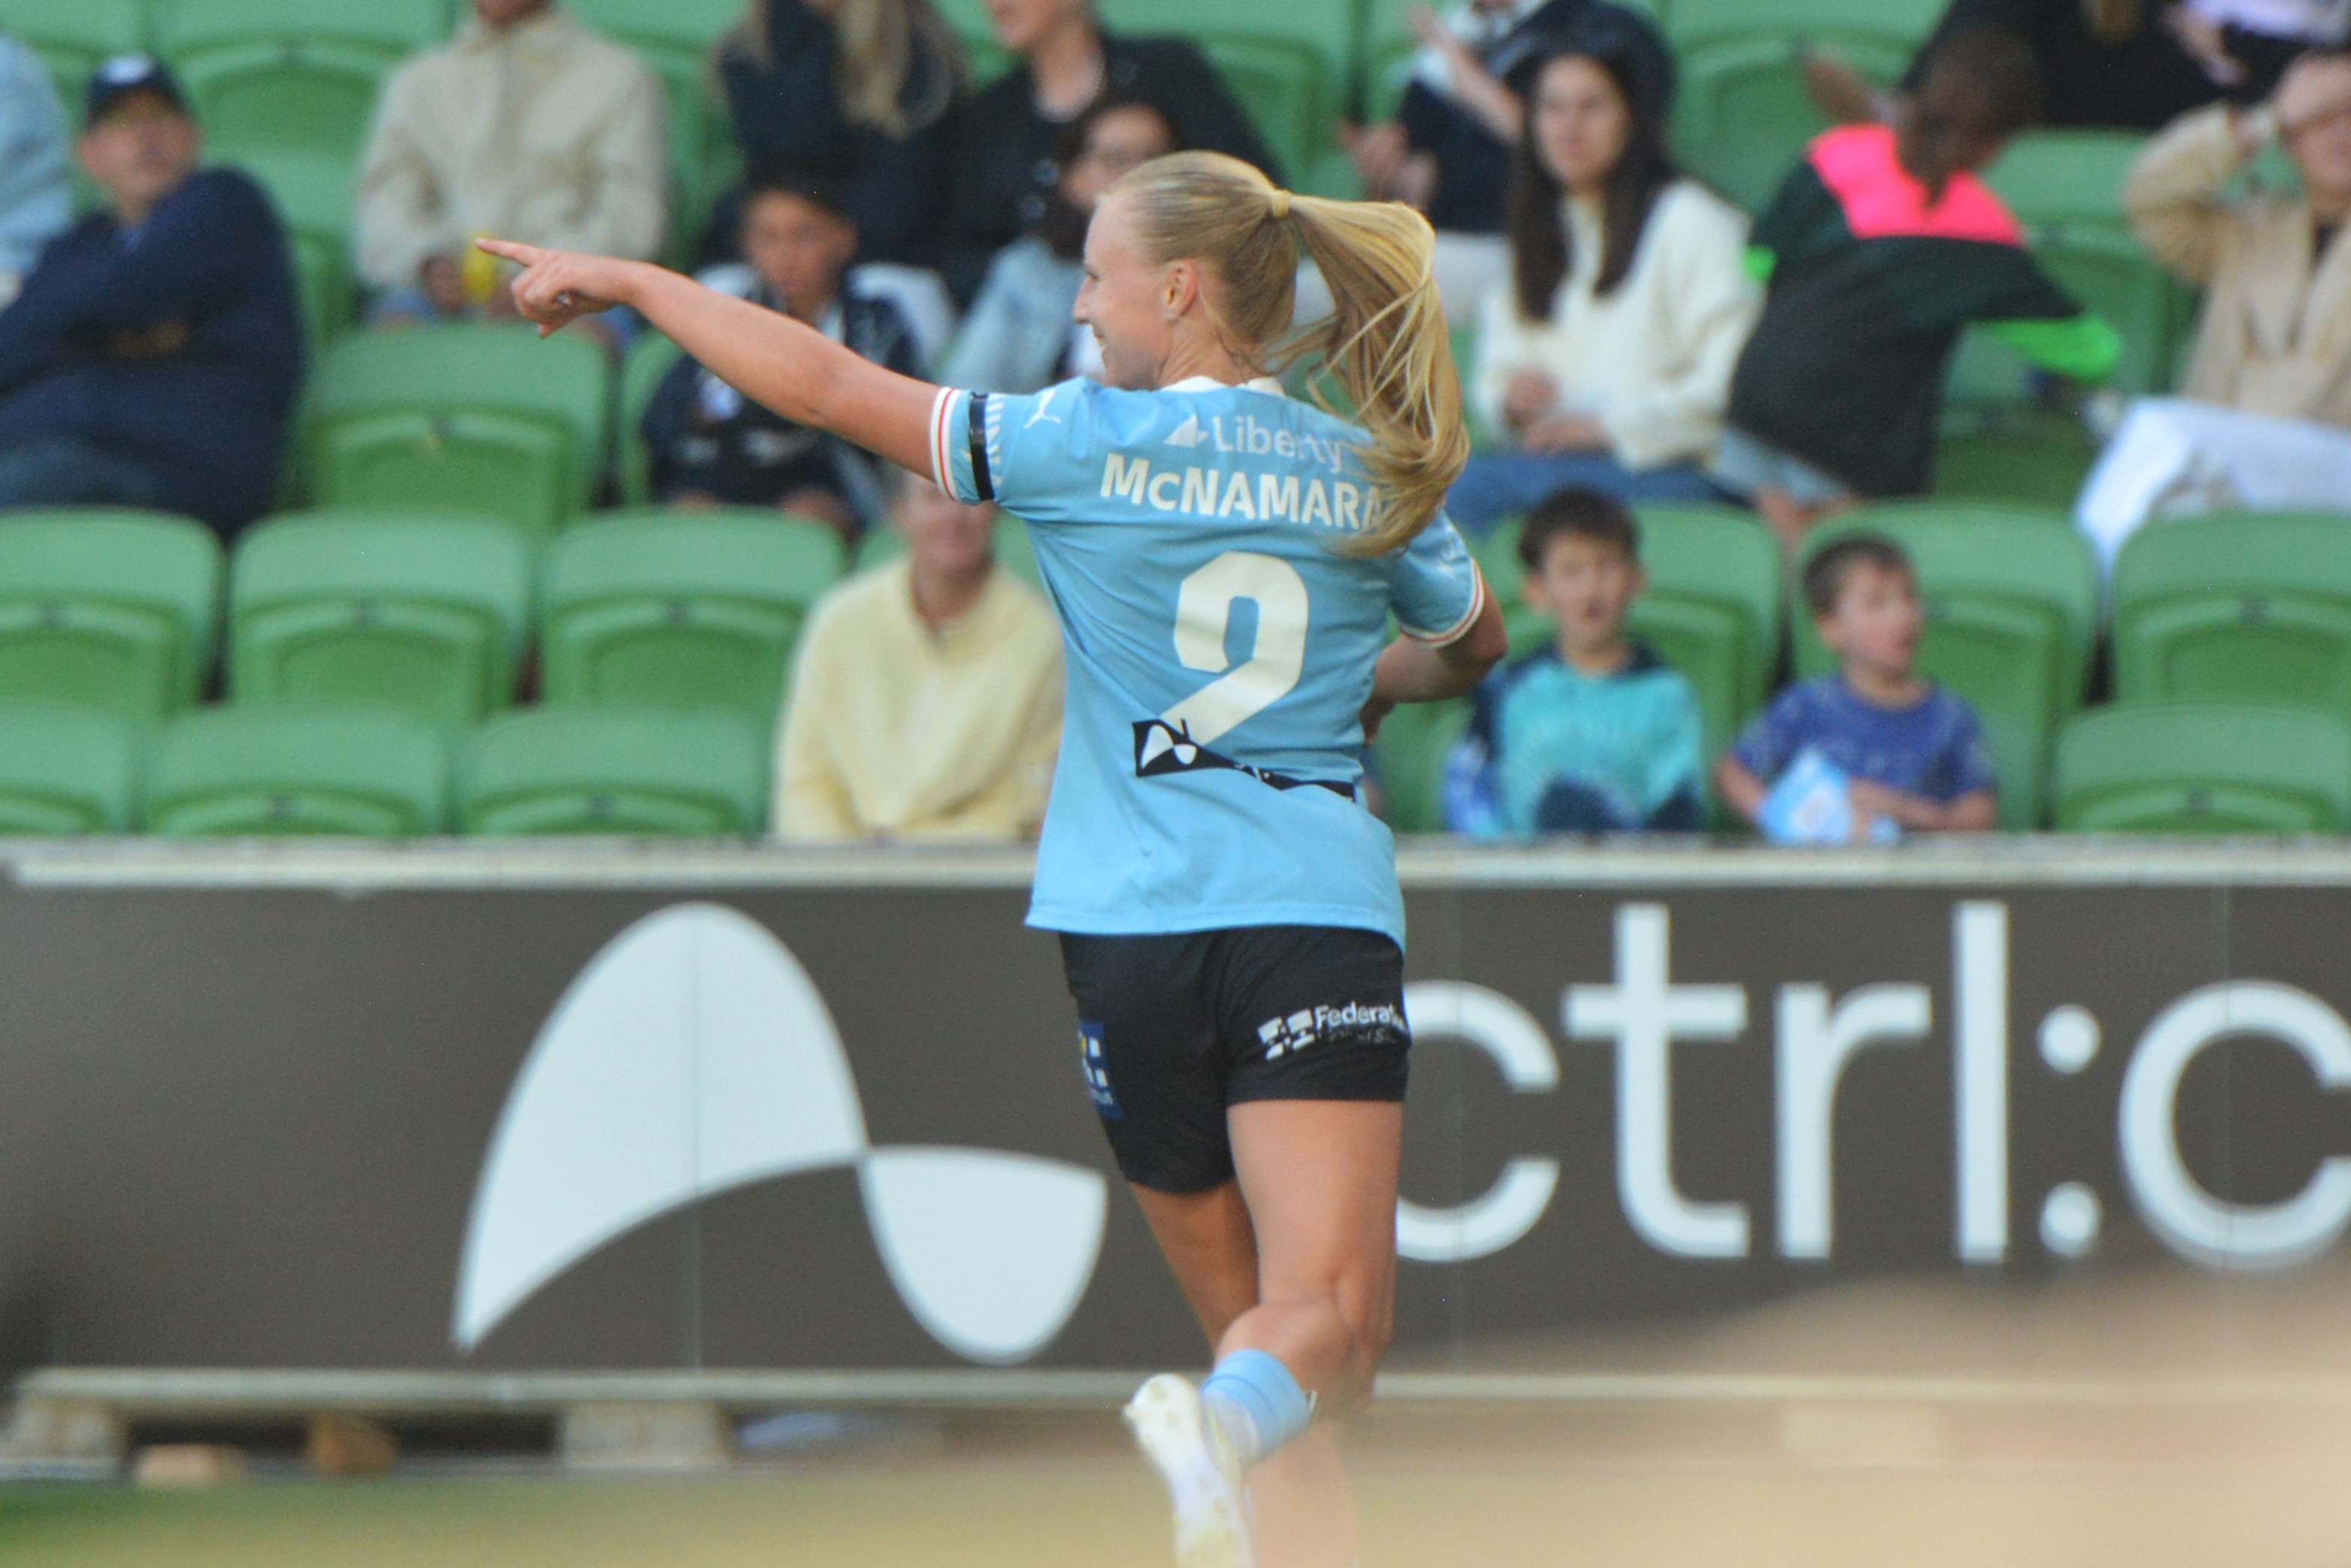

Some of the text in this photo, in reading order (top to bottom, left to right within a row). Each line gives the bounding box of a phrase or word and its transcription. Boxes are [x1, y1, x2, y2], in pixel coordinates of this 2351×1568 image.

[1211, 413, 1343, 474] Liberty
[1100, 453, 1384, 530] McNAMARA
[1159, 550, 1309, 747] 9
